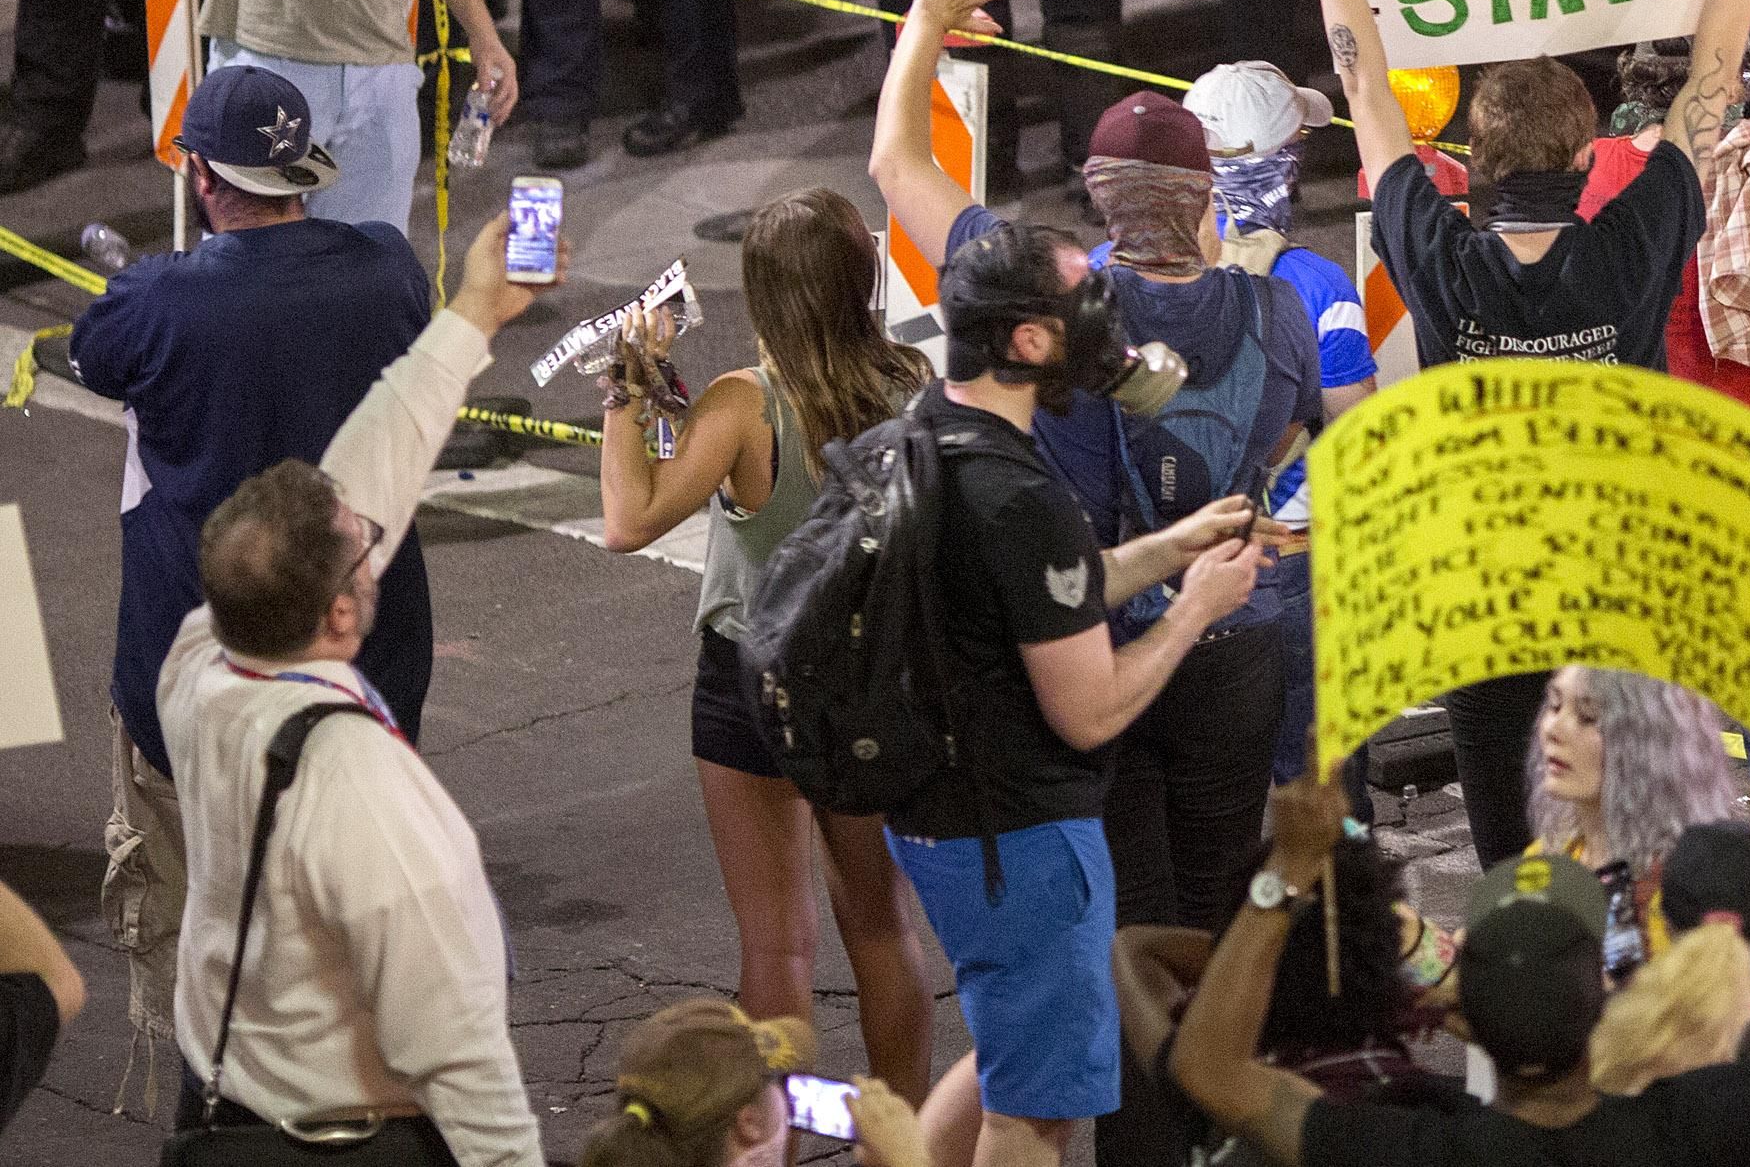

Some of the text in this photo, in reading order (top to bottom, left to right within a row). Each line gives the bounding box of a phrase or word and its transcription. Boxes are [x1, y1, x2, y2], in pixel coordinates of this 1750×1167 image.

[1334, 405, 1417, 477] END
[1439, 374, 1584, 415] WHITE
[1526, 416, 1679, 469] BLACK
[1414, 576, 1532, 654] YOUR
